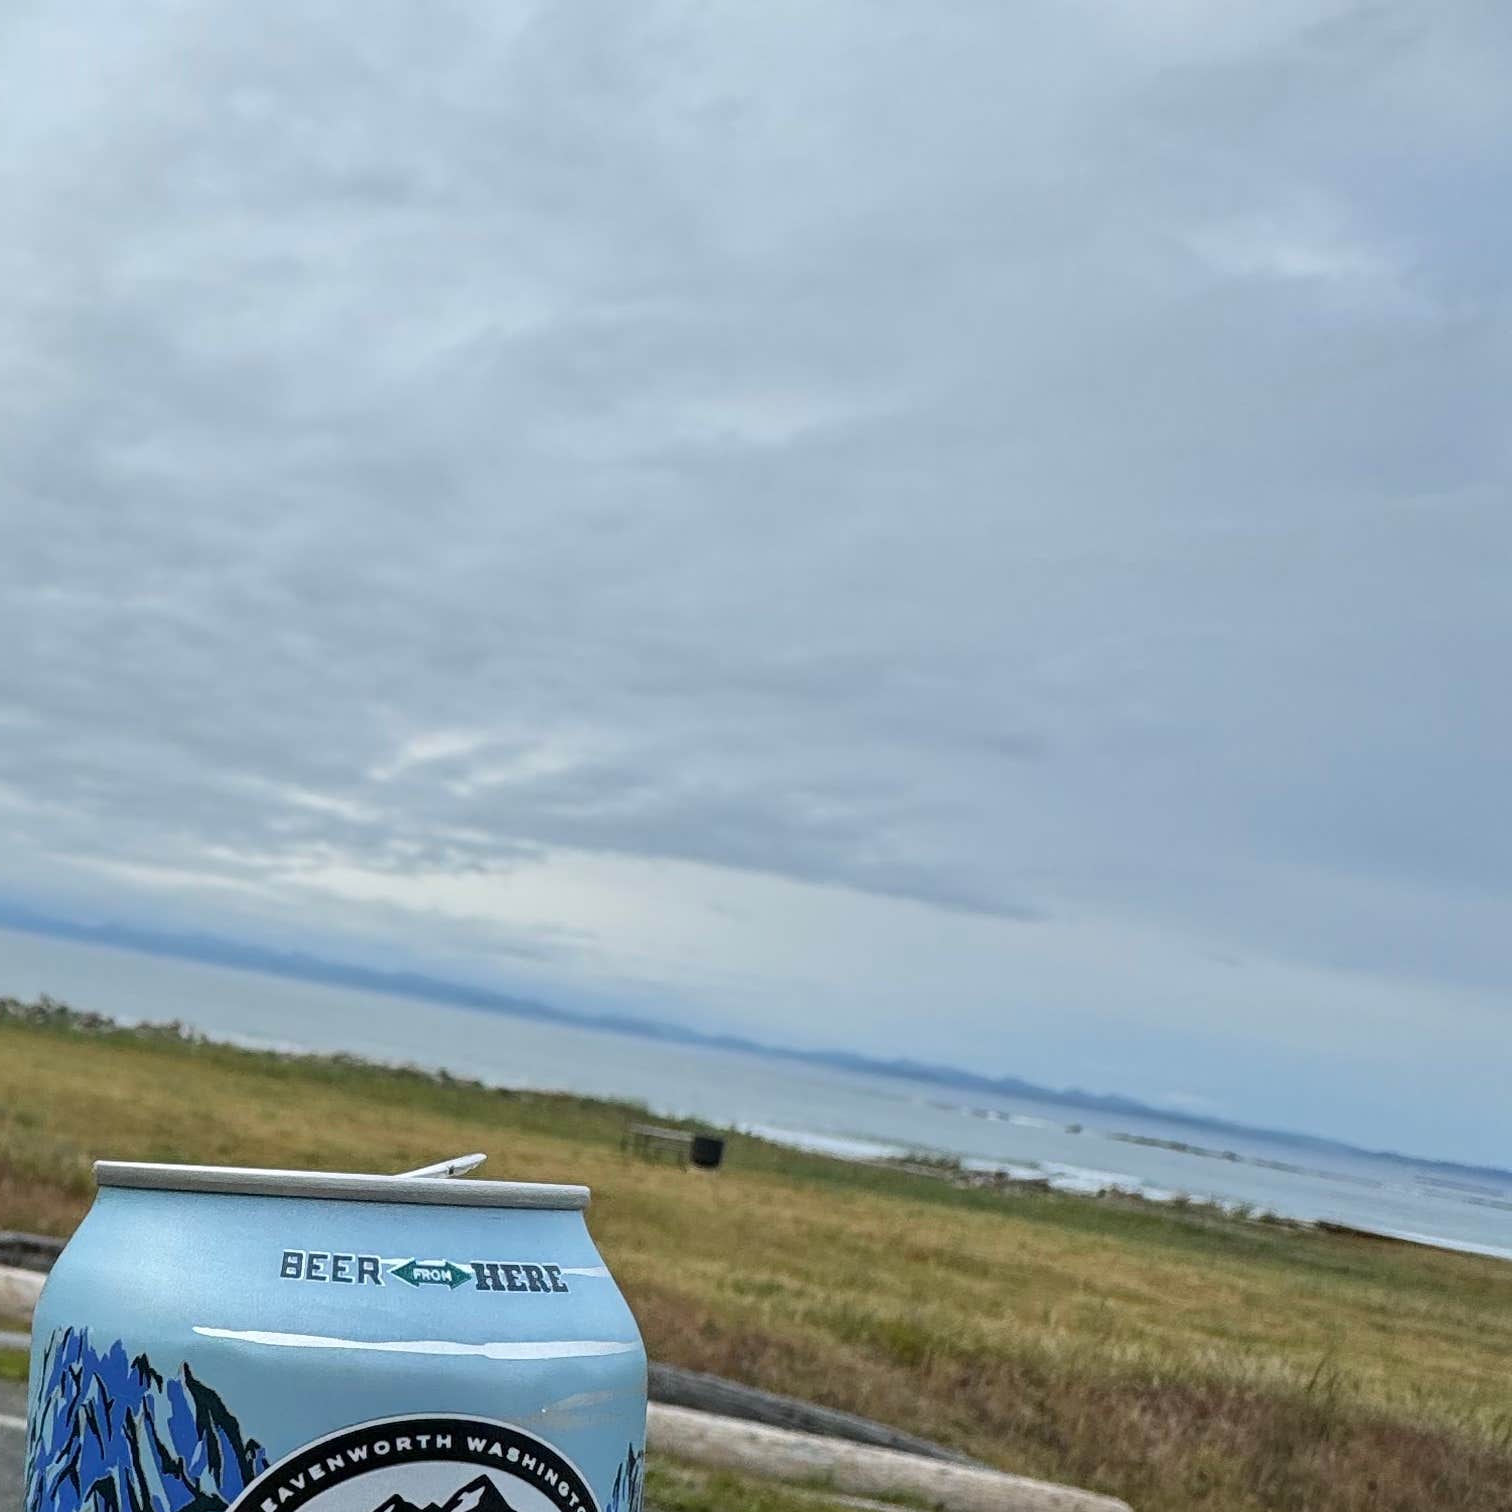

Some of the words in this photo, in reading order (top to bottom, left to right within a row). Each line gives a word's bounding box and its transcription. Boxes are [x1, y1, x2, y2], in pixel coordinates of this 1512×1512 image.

[280, 1250, 383, 1286] BEER
[413, 1266, 453, 1283] FROM
[471, 1261, 570, 1293] HERE
